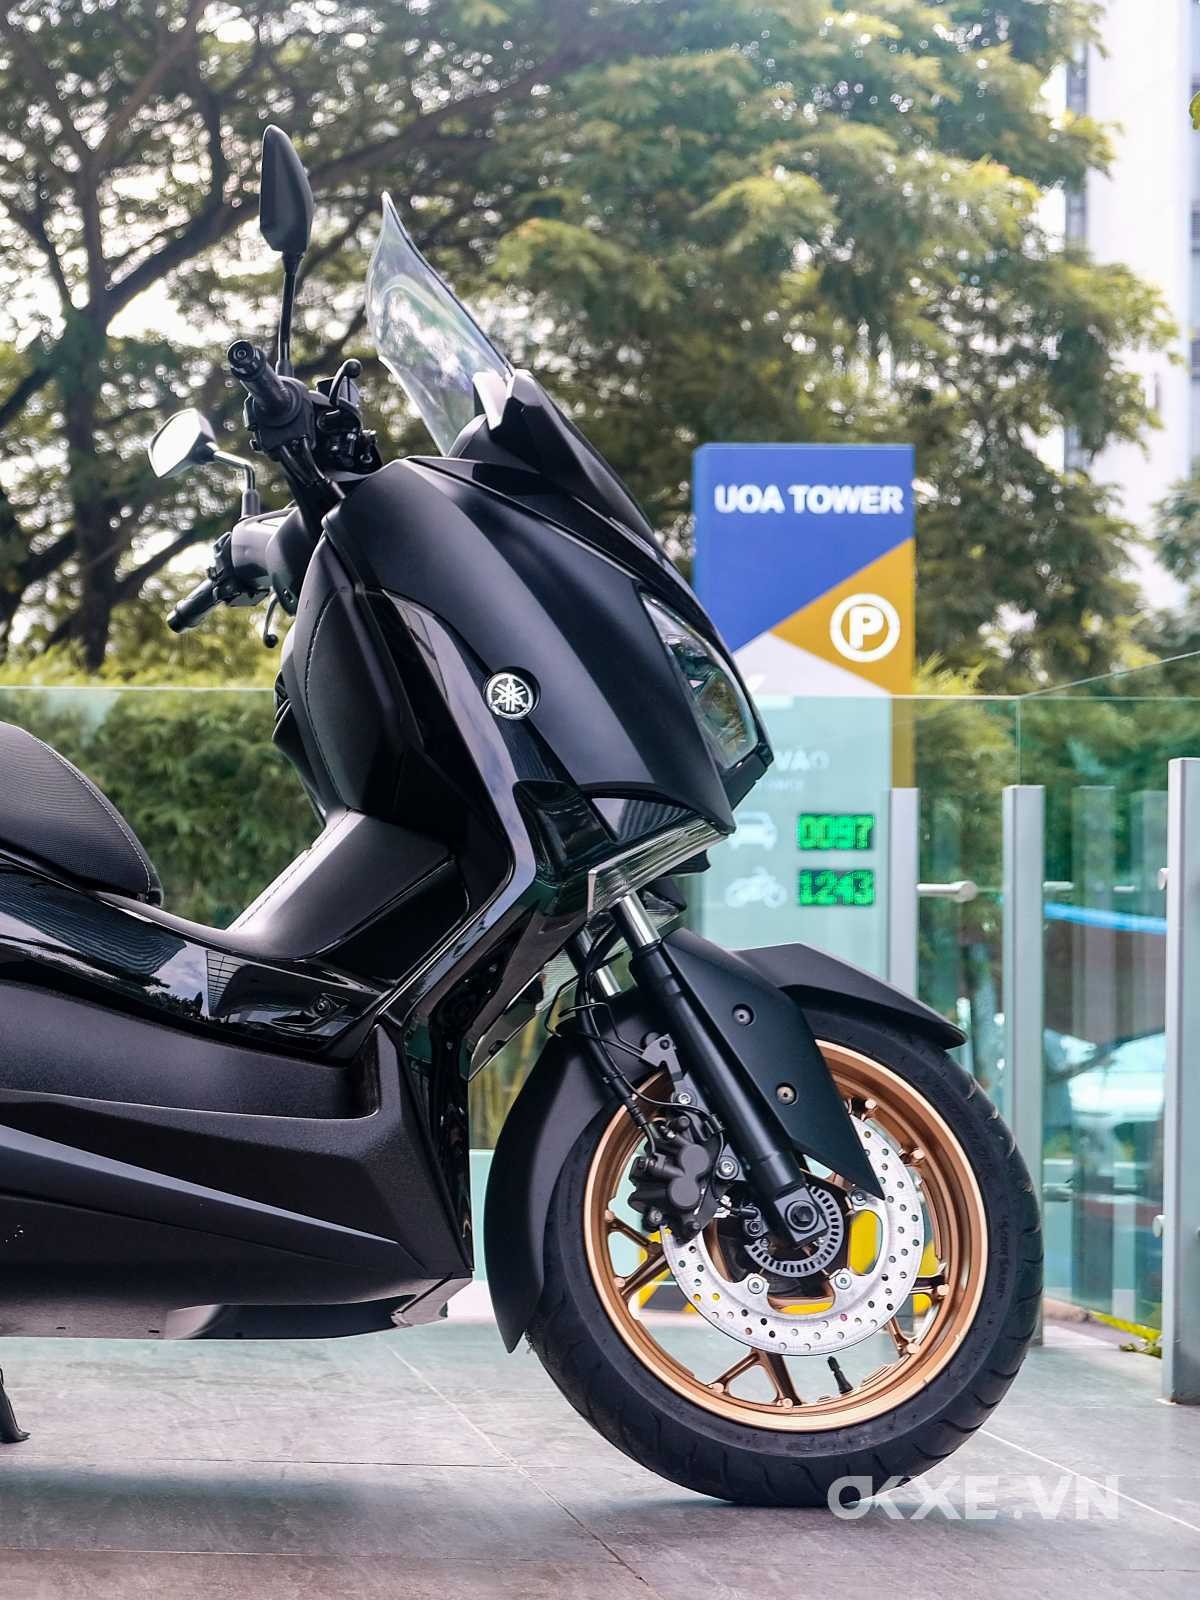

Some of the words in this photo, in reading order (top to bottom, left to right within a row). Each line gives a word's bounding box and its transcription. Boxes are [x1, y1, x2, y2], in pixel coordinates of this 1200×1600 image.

[714, 484, 785, 514] UOA
[788, 485, 904, 514] TOWER
[849, 605, 884, 650] P
[798, 814, 875, 849] 0097
[799, 870, 875, 906] 1243
